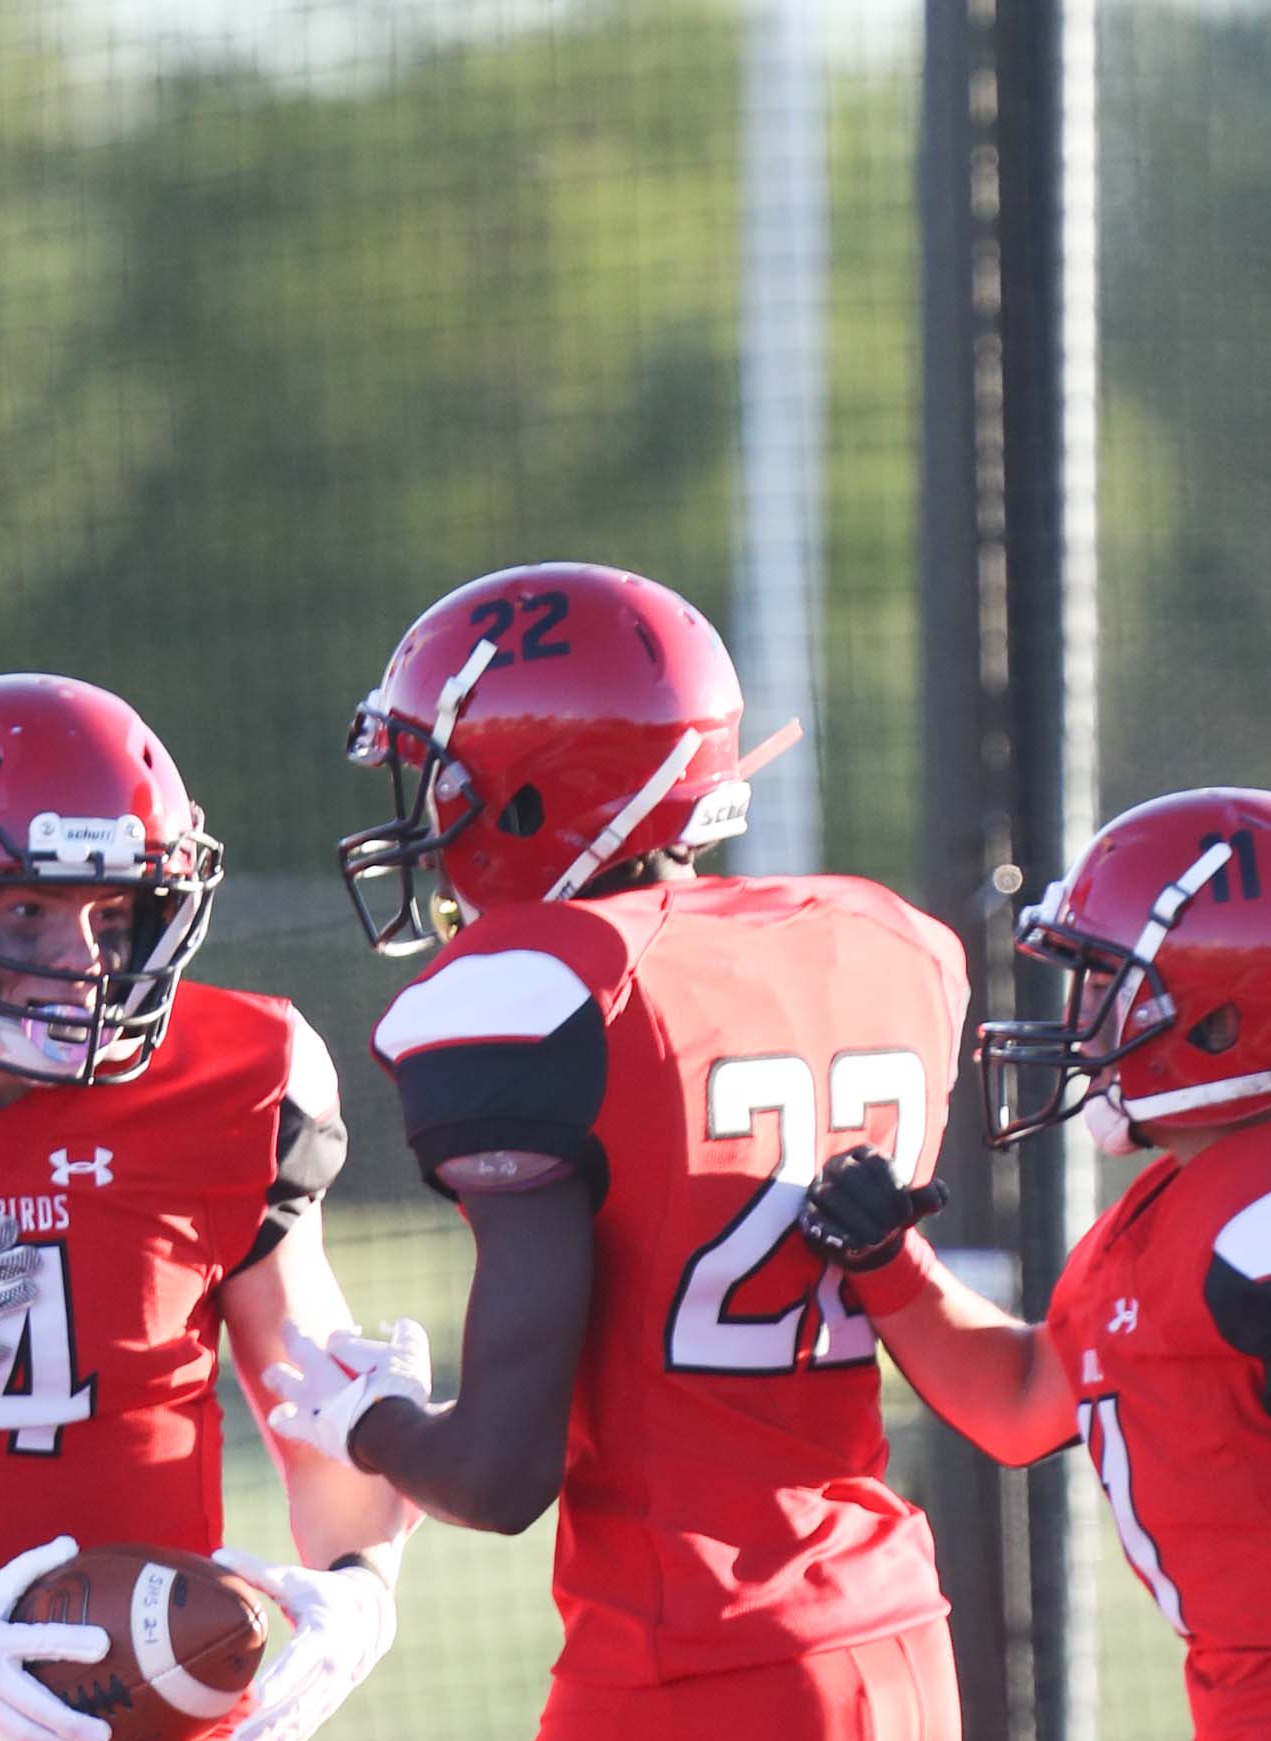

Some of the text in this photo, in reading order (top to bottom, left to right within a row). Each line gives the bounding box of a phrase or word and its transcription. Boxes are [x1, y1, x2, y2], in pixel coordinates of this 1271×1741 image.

[470, 591, 570, 669] 22
[1199, 829, 1261, 903] 11
[665, 1048, 927, 1375] 22
